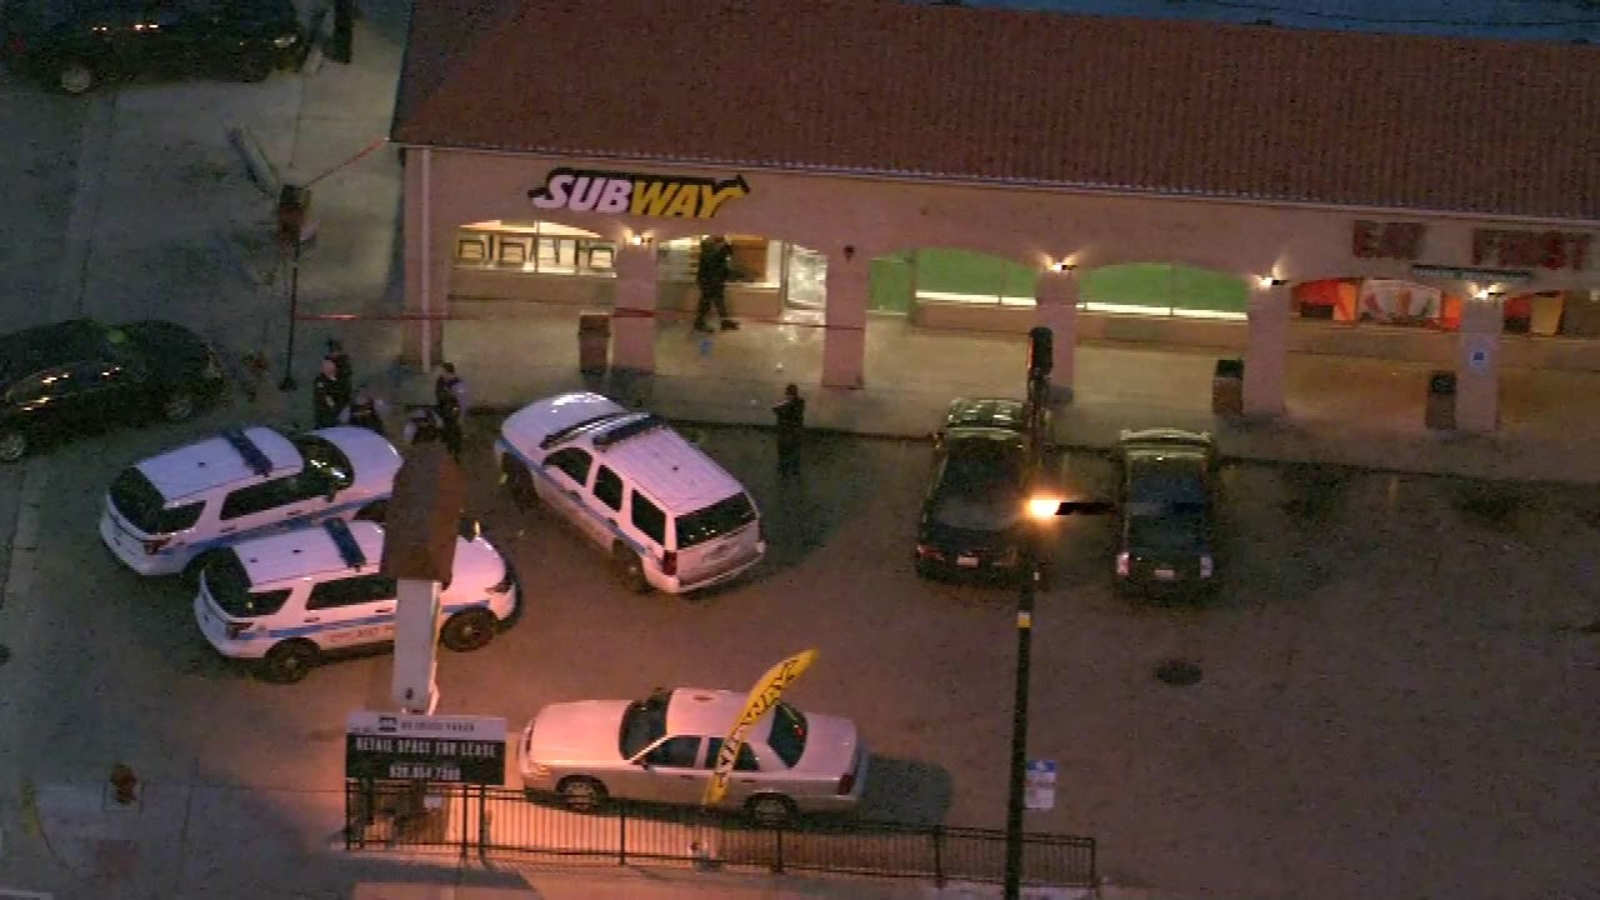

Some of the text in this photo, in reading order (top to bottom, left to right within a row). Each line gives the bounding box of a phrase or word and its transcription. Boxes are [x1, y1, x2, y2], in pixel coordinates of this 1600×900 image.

[530, 170, 749, 219] SUBWAY
[355, 737, 496, 758] RETAIL SPACE FOR LEASE
